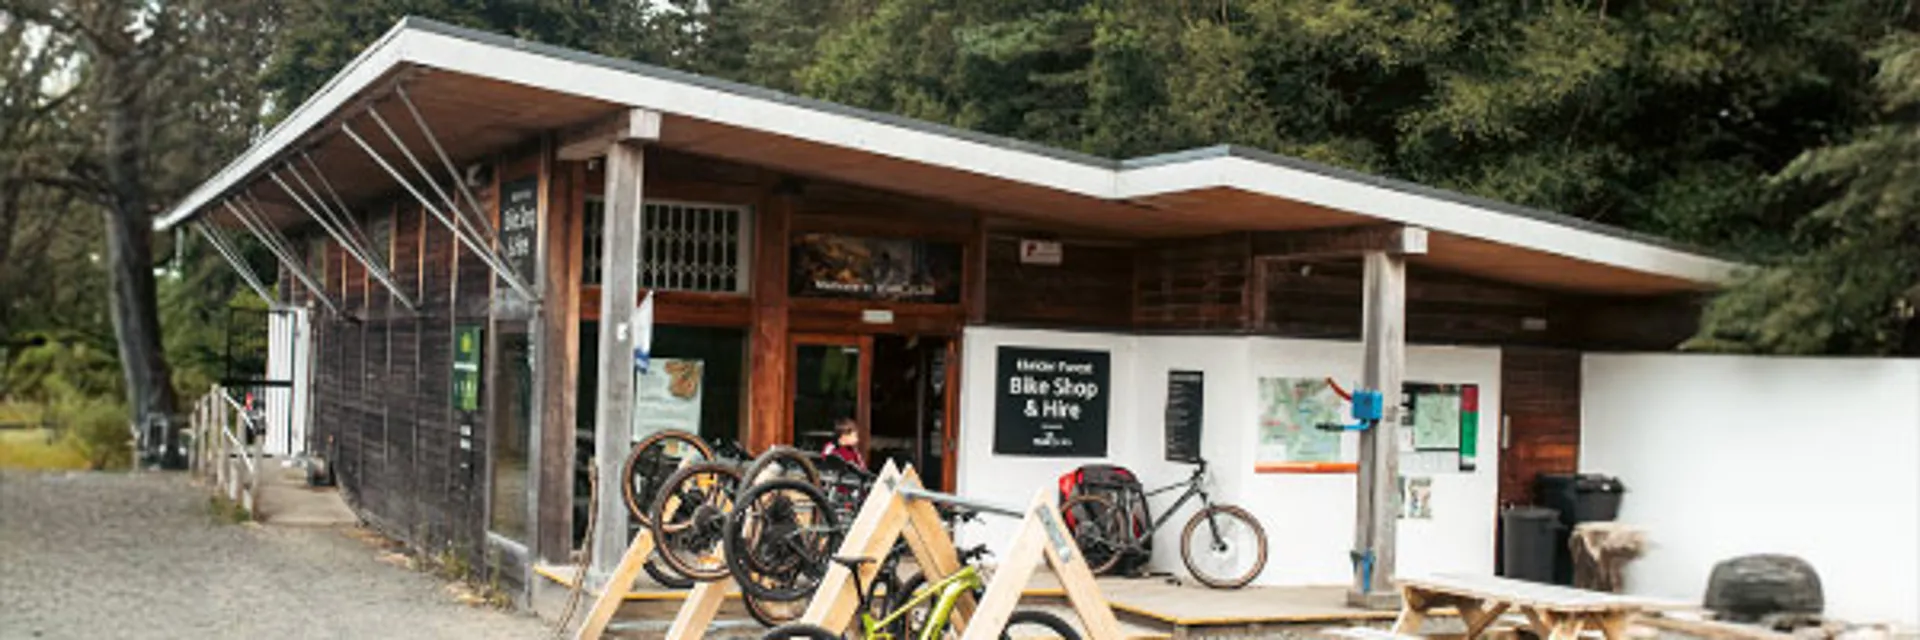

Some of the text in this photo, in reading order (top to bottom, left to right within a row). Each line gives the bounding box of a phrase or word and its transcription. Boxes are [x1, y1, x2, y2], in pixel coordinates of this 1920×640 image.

[1009, 377, 1099, 399] Bike Shop
[1023, 400, 1082, 419] & Hire
